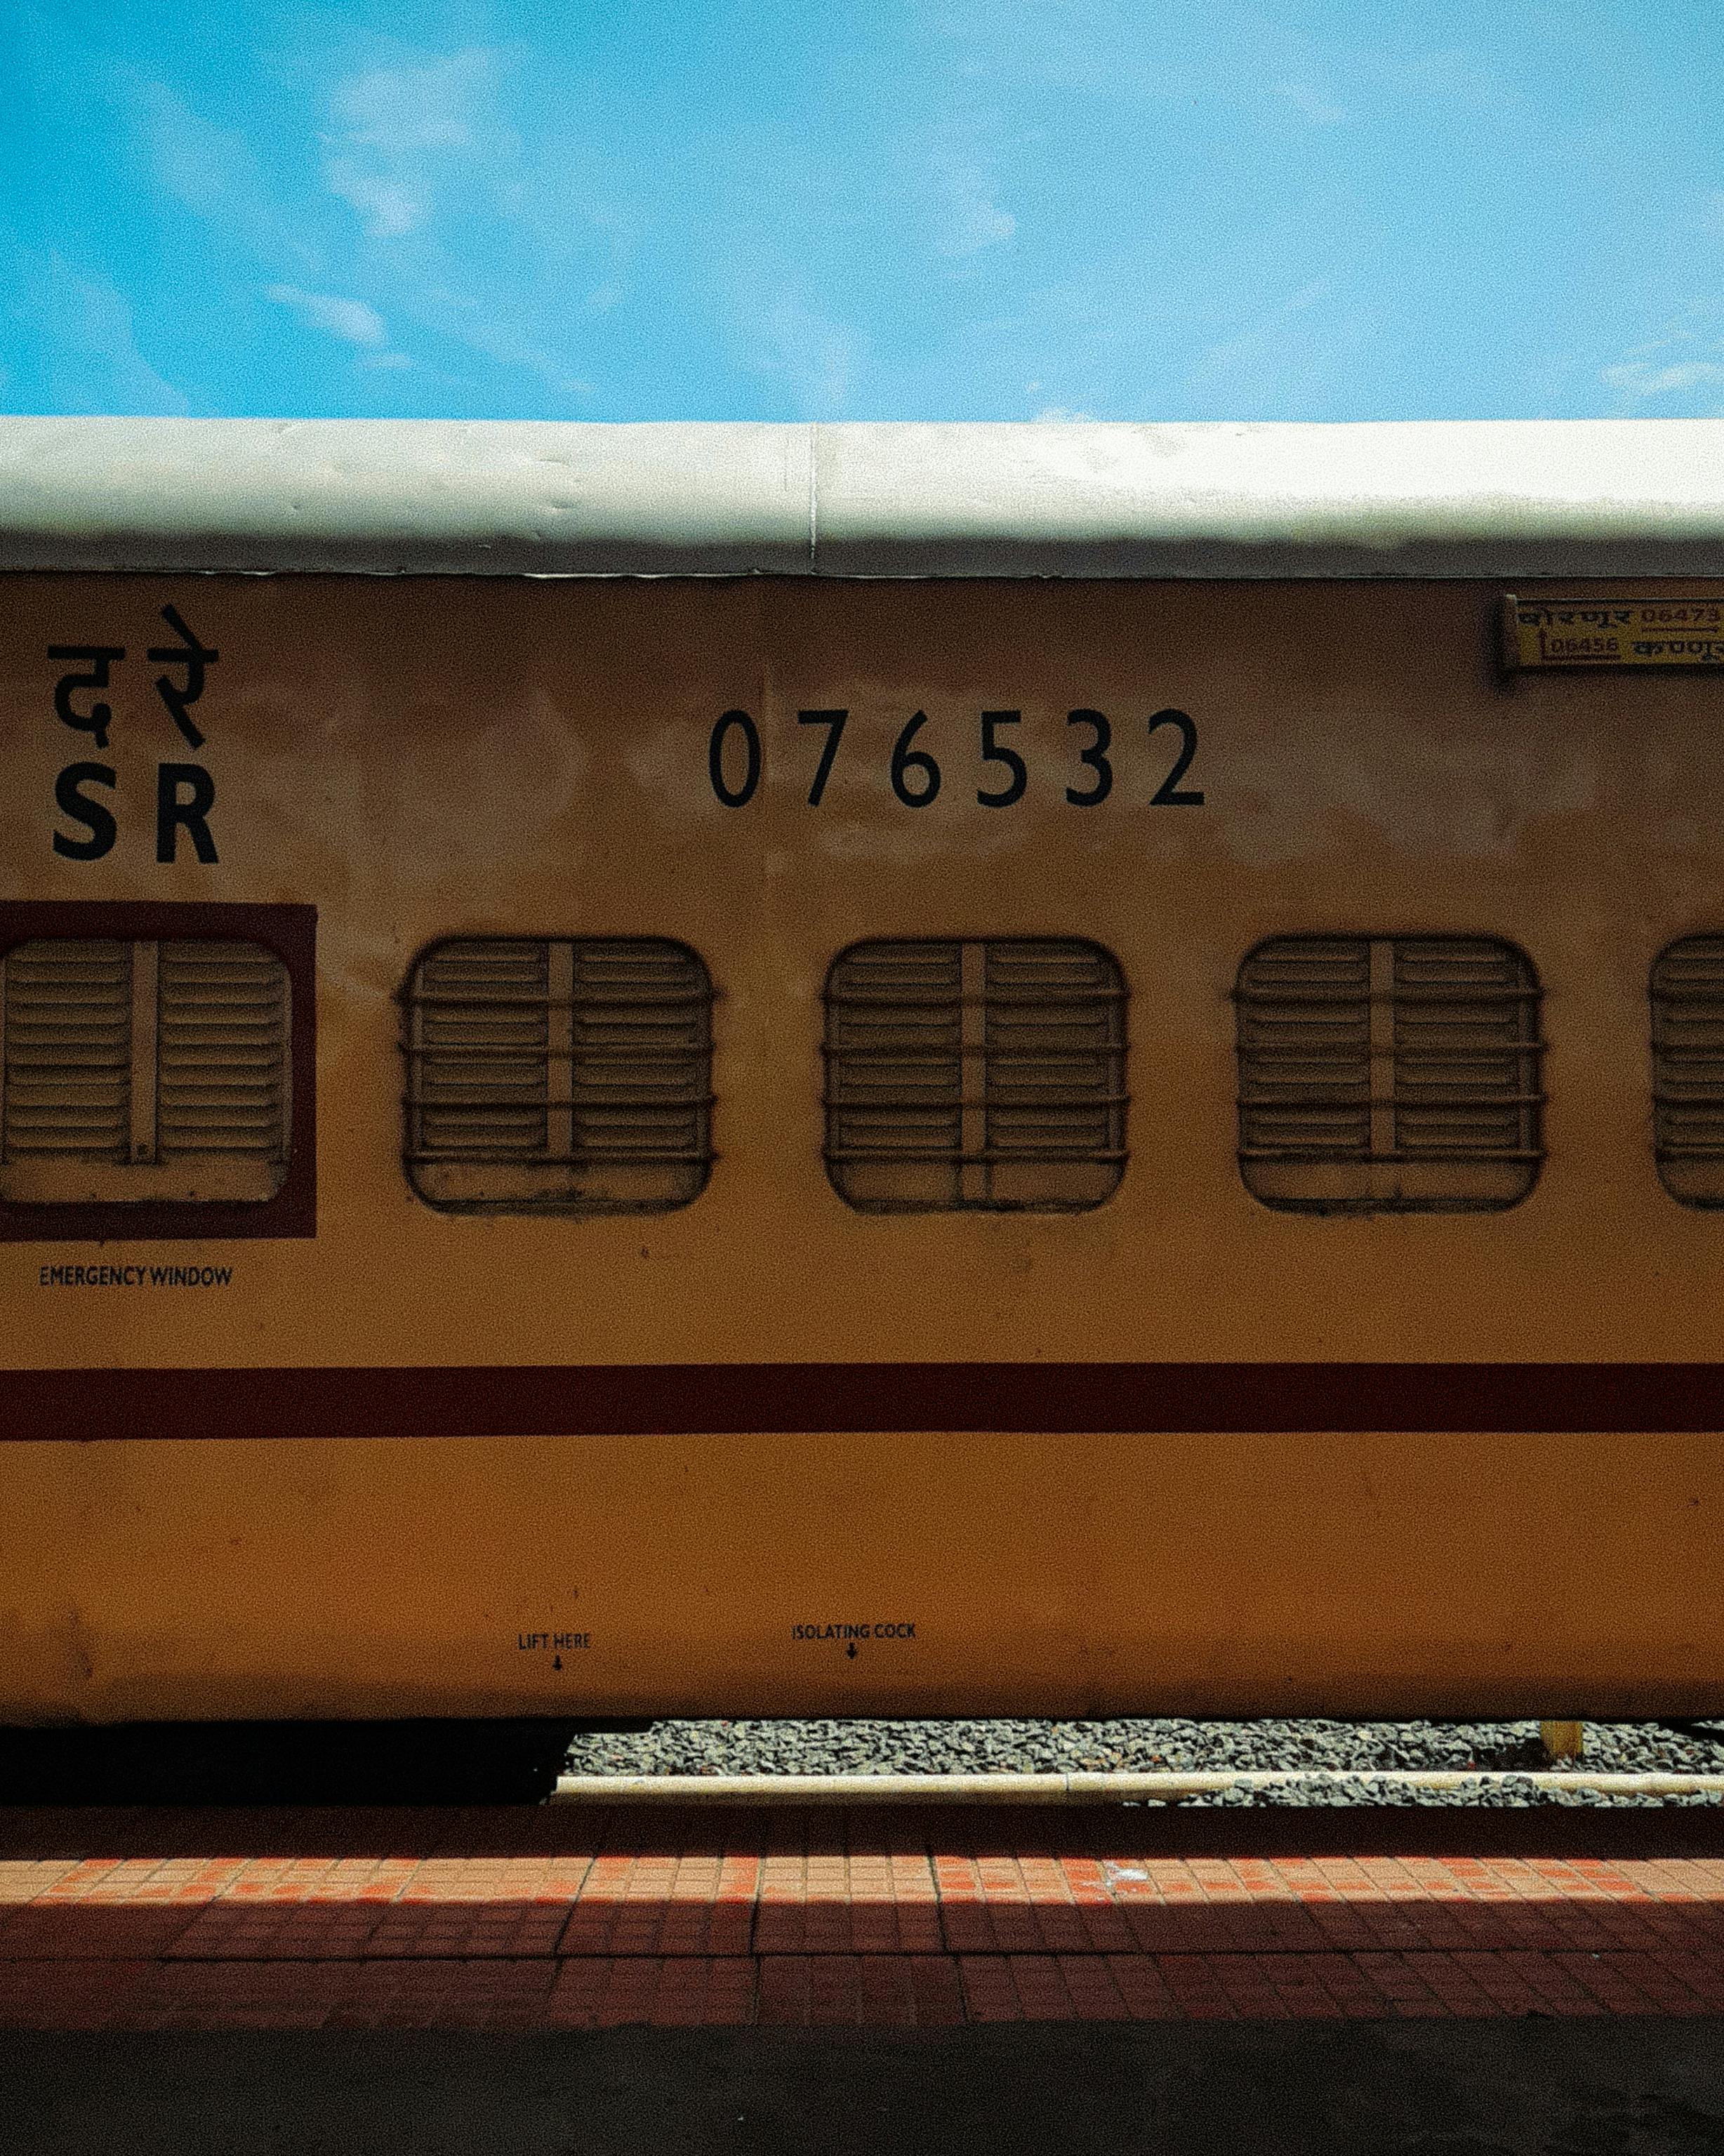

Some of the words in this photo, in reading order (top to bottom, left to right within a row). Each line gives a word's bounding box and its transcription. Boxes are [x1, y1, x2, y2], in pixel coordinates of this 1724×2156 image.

[1551, 637, 1619, 653] 06456
[708, 708, 1205, 808] 076532
[39, 1266, 146, 1286] EMERGENCY
[150, 1267, 233, 1286] WINDOW
[792, 1624, 870, 1640] ISOLATING
[873, 1623, 916, 1639] COCK
[518, 1633, 549, 1651] LIFT
[552, 1633, 590, 1650] HERE
